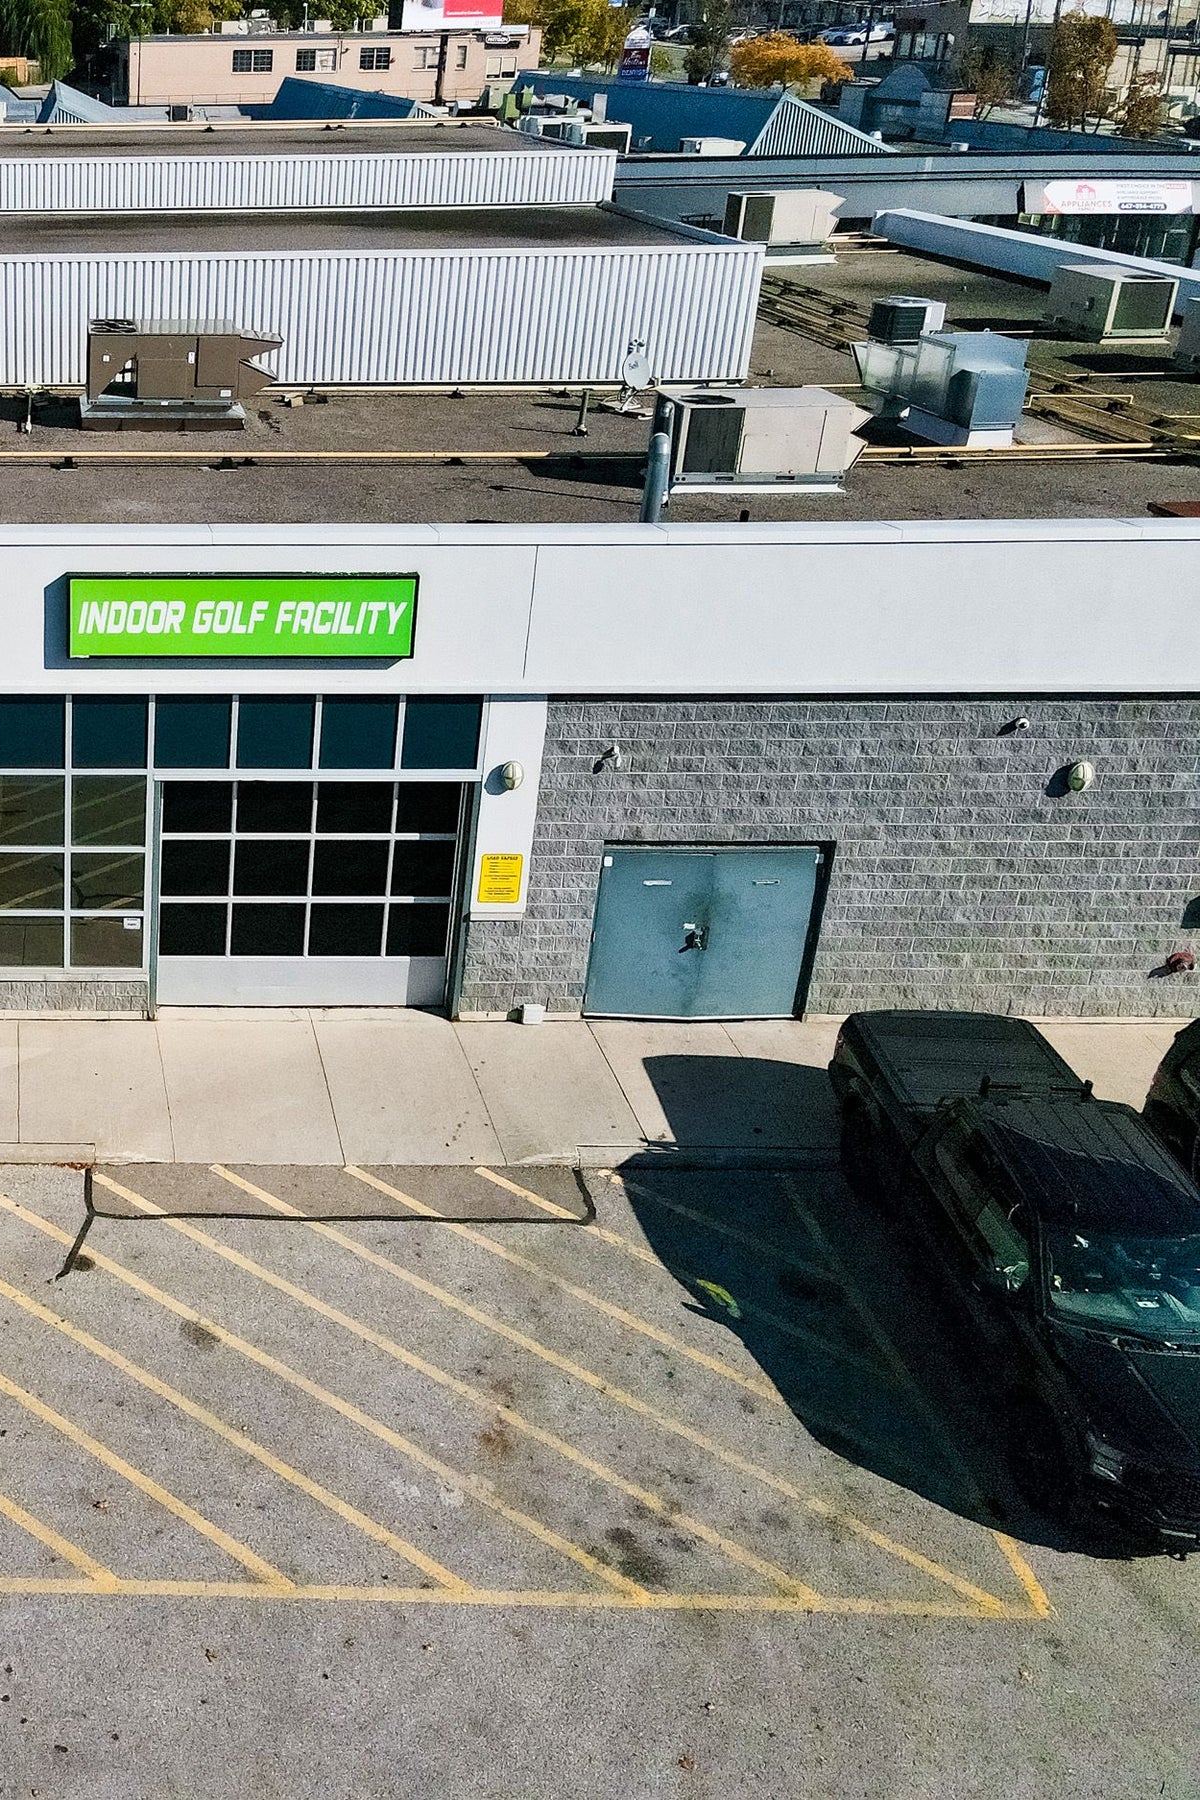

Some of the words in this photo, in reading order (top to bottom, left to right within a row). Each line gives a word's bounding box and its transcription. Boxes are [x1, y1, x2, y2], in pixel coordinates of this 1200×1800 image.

[1060, 200, 1113, 208] APPLIANCES
[78, 600, 187, 634] INDOOR
[192, 600, 269, 634] GOLF
[274, 601, 408, 635] FACILITY
